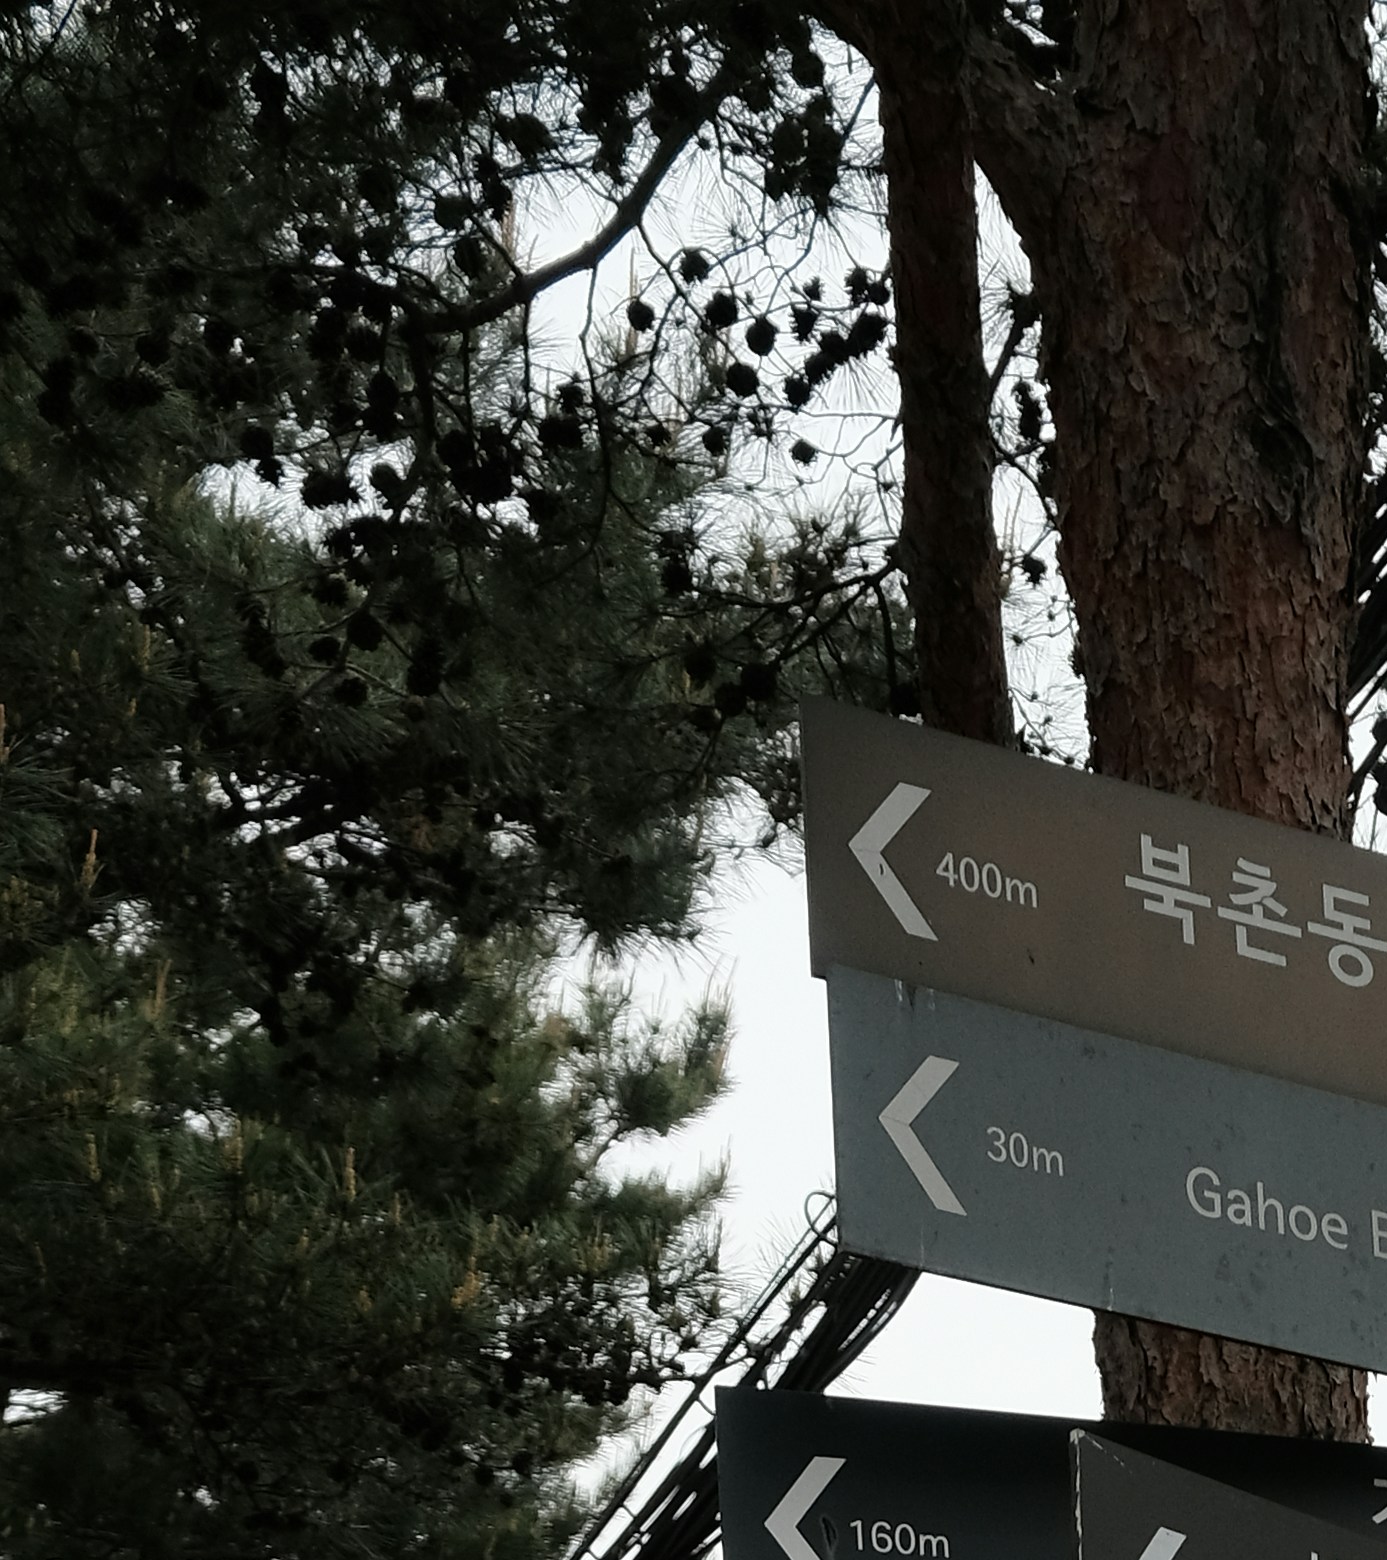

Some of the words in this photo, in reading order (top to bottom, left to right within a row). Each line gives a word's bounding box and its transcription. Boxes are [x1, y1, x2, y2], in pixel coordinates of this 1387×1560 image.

[936, 853, 1037, 908] 400m
[987, 1127, 1063, 1176] 30m
[1187, 1167, 1348, 1249] Gahoe
[850, 1520, 949, 1558] 160m
